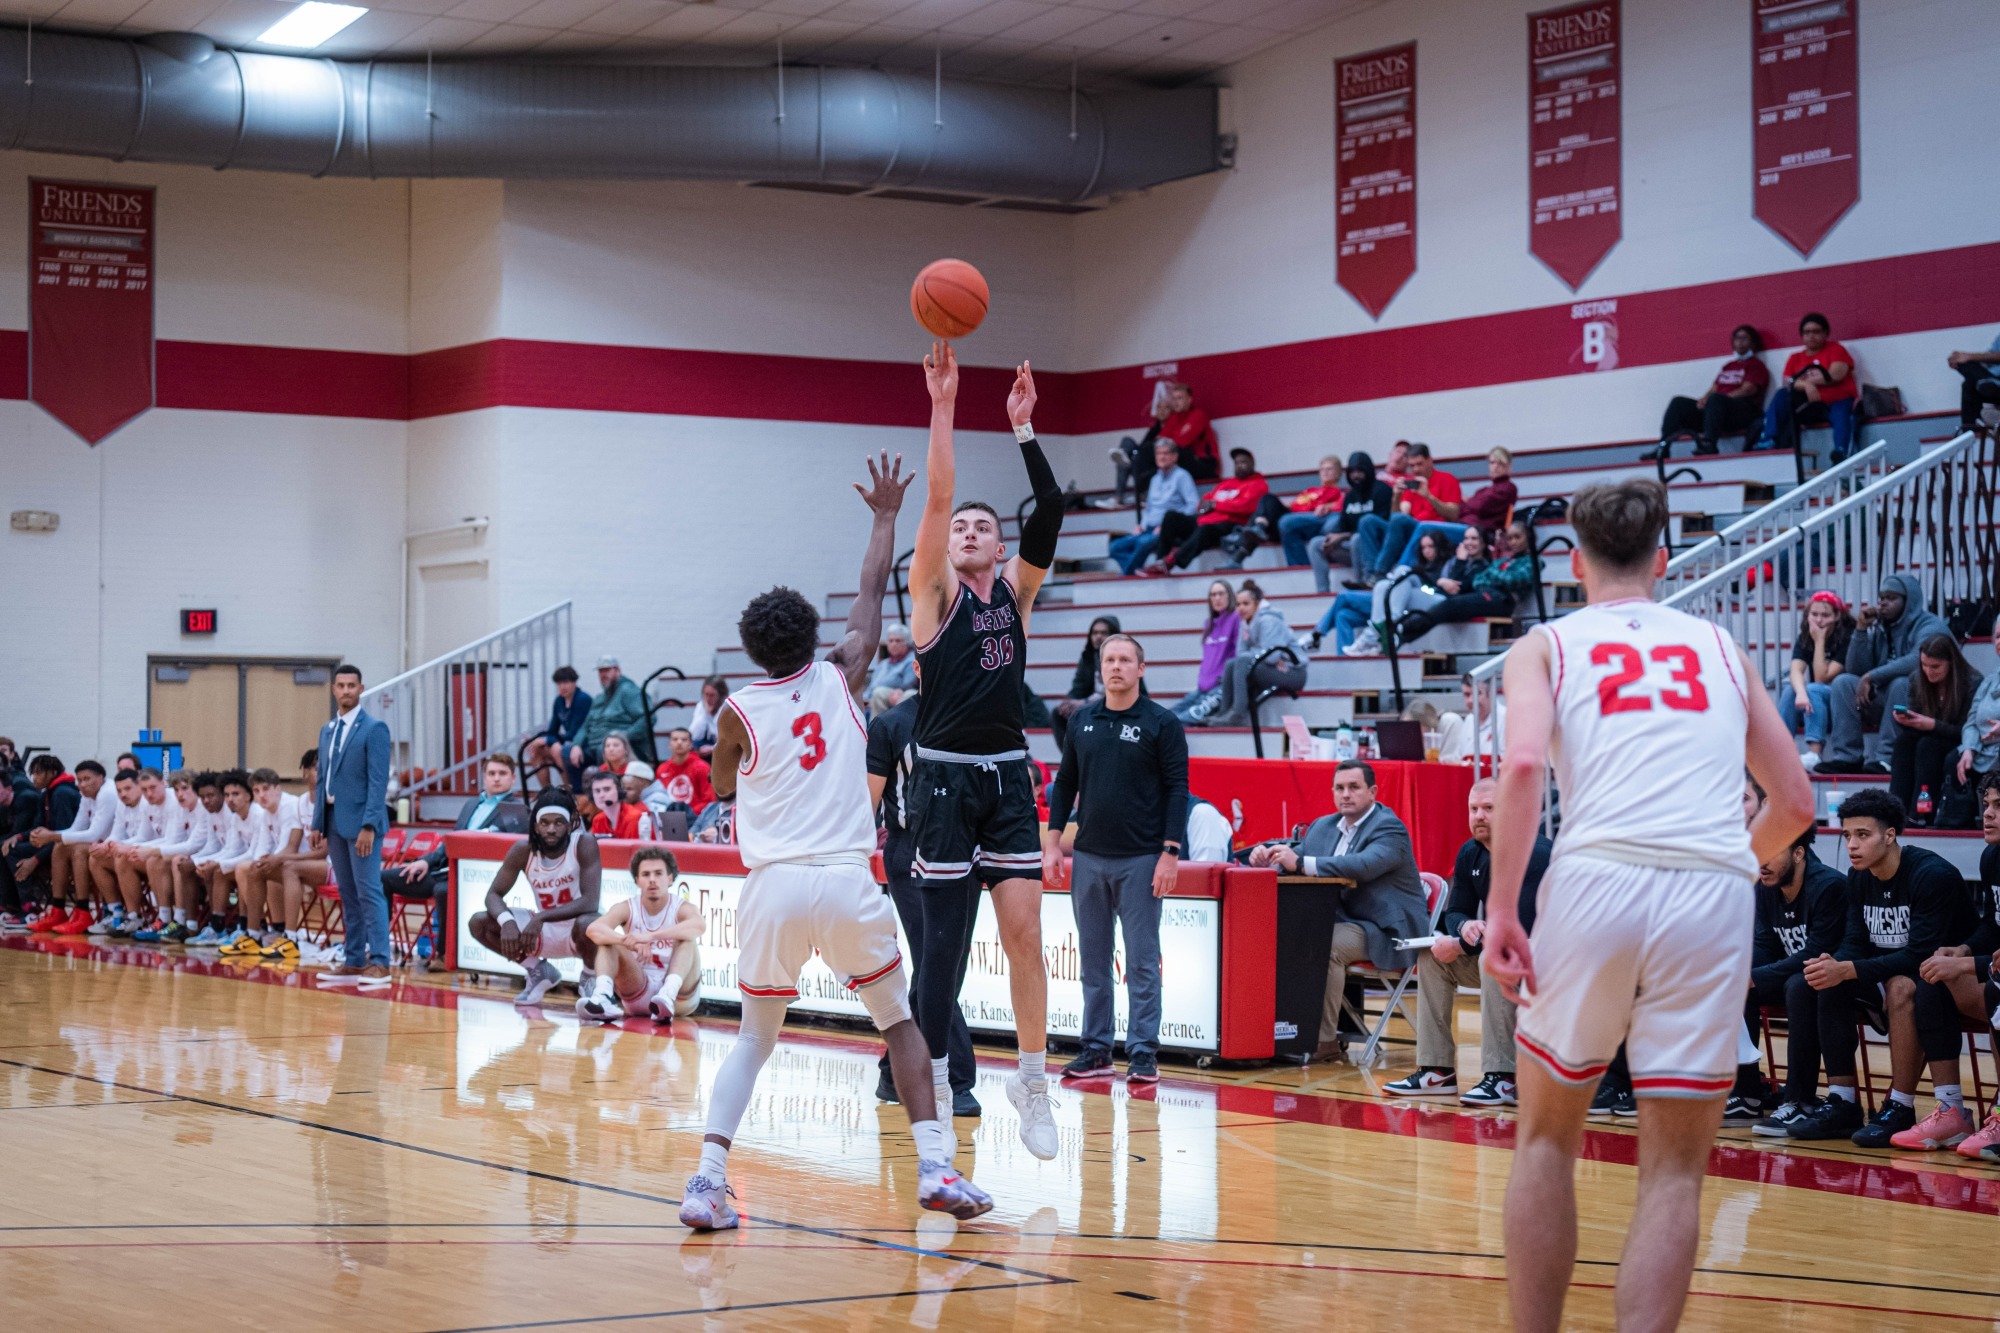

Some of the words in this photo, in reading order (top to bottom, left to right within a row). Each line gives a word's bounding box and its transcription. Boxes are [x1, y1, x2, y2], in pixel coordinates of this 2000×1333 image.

[1537, 6, 1611, 42] FRIENDS
[1342, 53, 1409, 86] FRIENDS
[43, 186, 143, 214] FRIENDS
[41, 208, 143, 226] UNIVERSITY
[89, 235, 132, 248] BASKETBALL
[58, 250, 81, 259] KCAC
[81, 251, 128, 262] CHAMPIONS
[125, 280, 147, 290] 2017
[1571, 299, 1617, 319] SECTION
[1583, 322, 1605, 363] B
[1143, 362, 1178, 379] SECTION
[189, 611, 212, 631] EXIT
[1590, 643, 1710, 717] 23
[792, 712, 827, 771] 3
[1120, 724, 1141, 741] BC
[538, 888, 574, 909] 24
[1160, 908, 1208, 928] 16-295-5700
[980, 1001, 1015, 1022] Kansa
[1161, 1022, 1204, 1040] erence.
